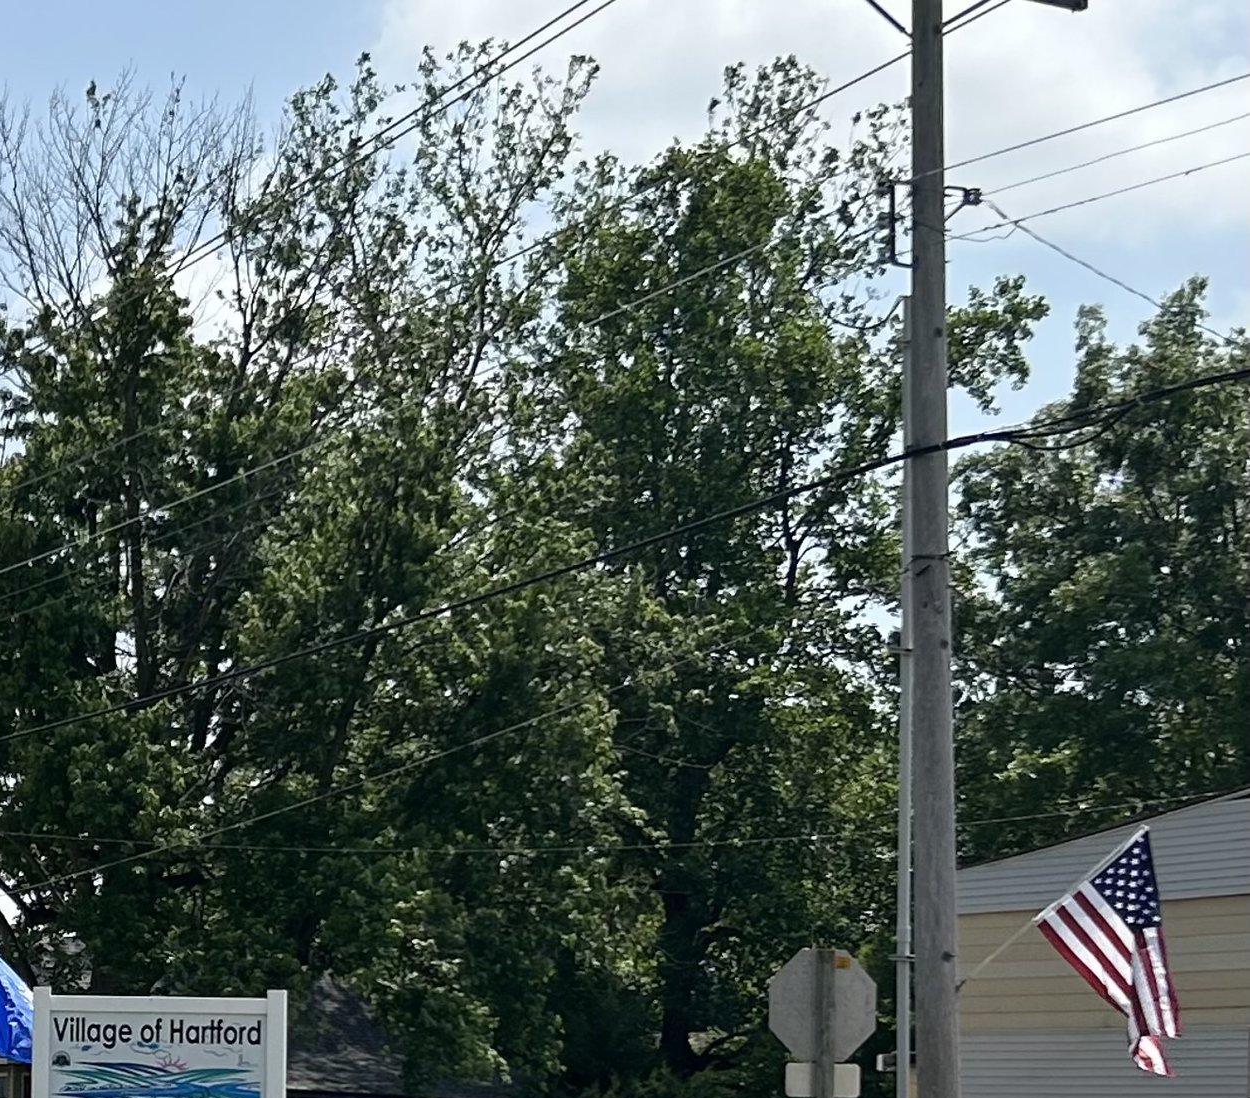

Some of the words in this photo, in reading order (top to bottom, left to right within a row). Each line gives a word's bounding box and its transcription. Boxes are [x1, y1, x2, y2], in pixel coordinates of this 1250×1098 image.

[53, 1017, 132, 1049] Village
[140, 1018, 164, 1043] of
[169, 1018, 261, 1046] Hartford
